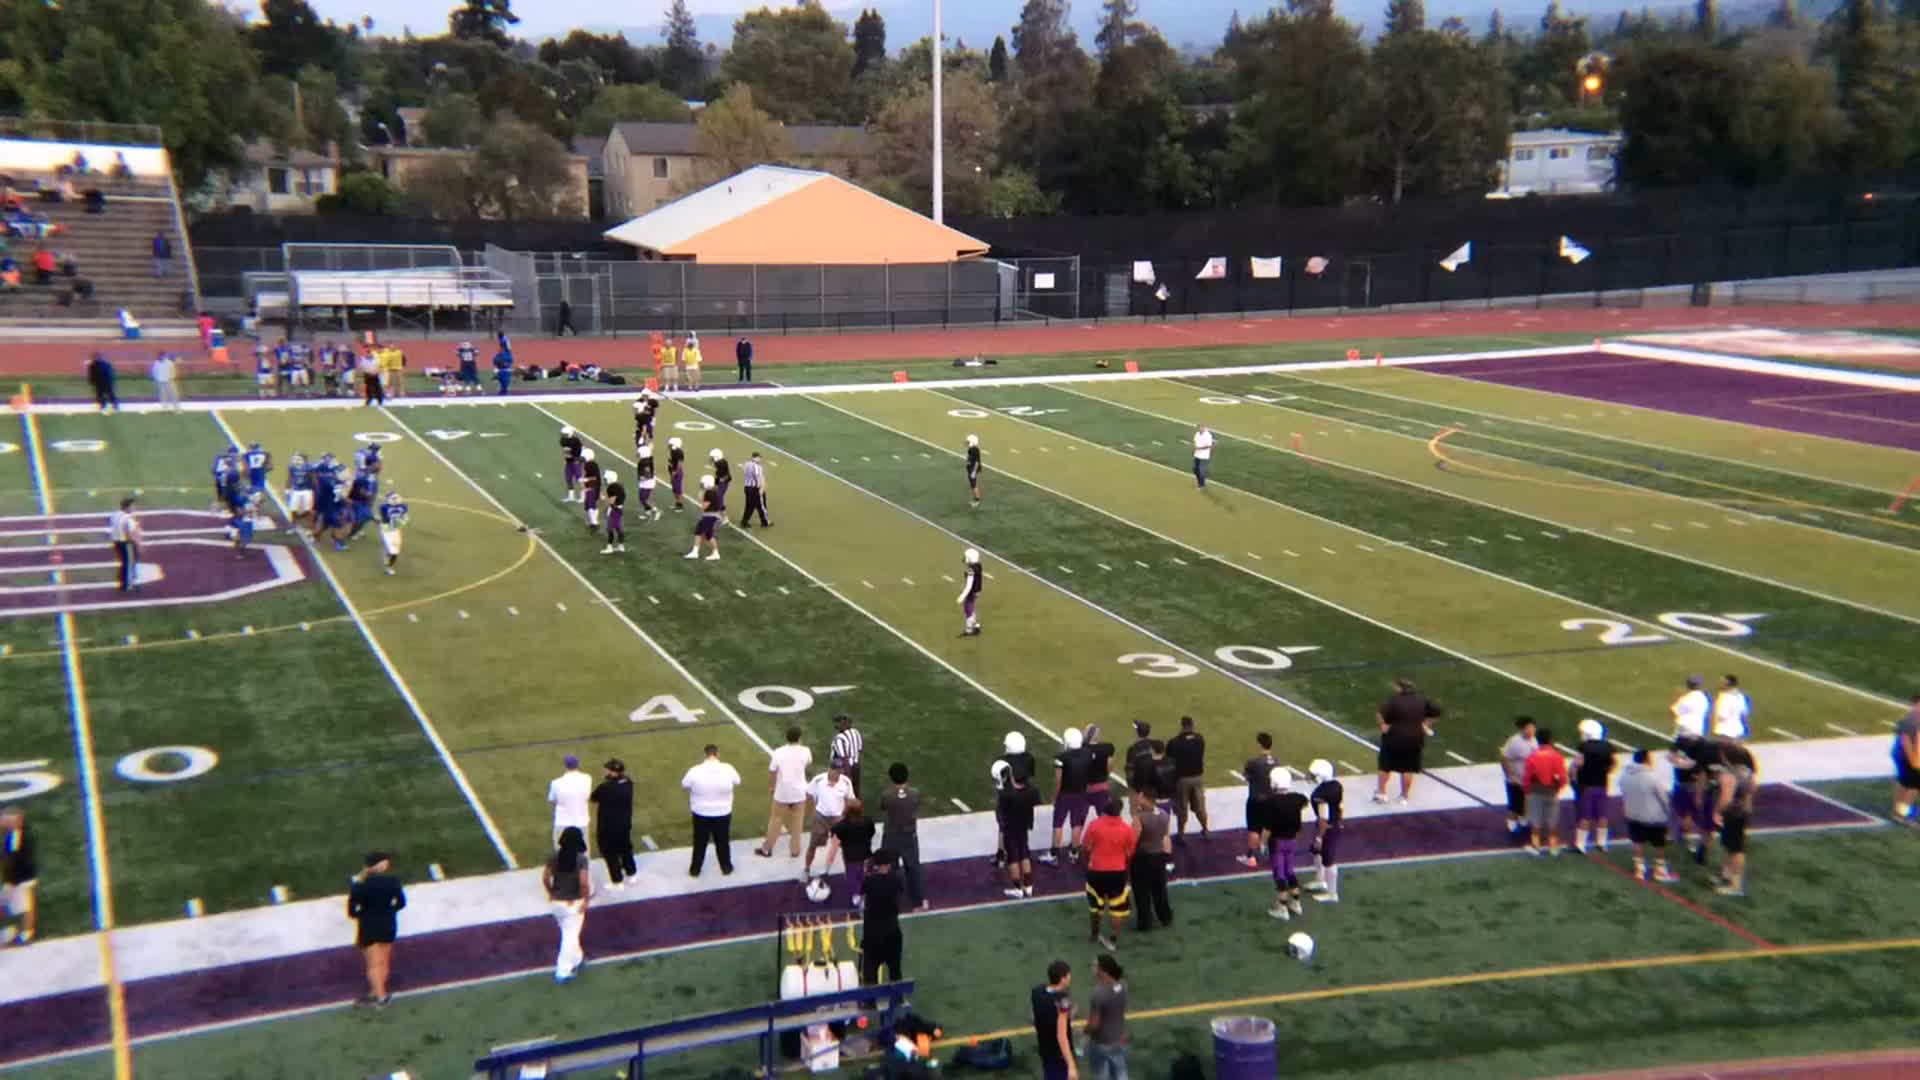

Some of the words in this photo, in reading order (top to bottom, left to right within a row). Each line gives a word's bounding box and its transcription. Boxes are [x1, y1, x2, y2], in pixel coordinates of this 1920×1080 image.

[1559, 612, 1753, 645] 20
[1116, 645, 1293, 678] 30
[629, 685, 815, 723] 40
